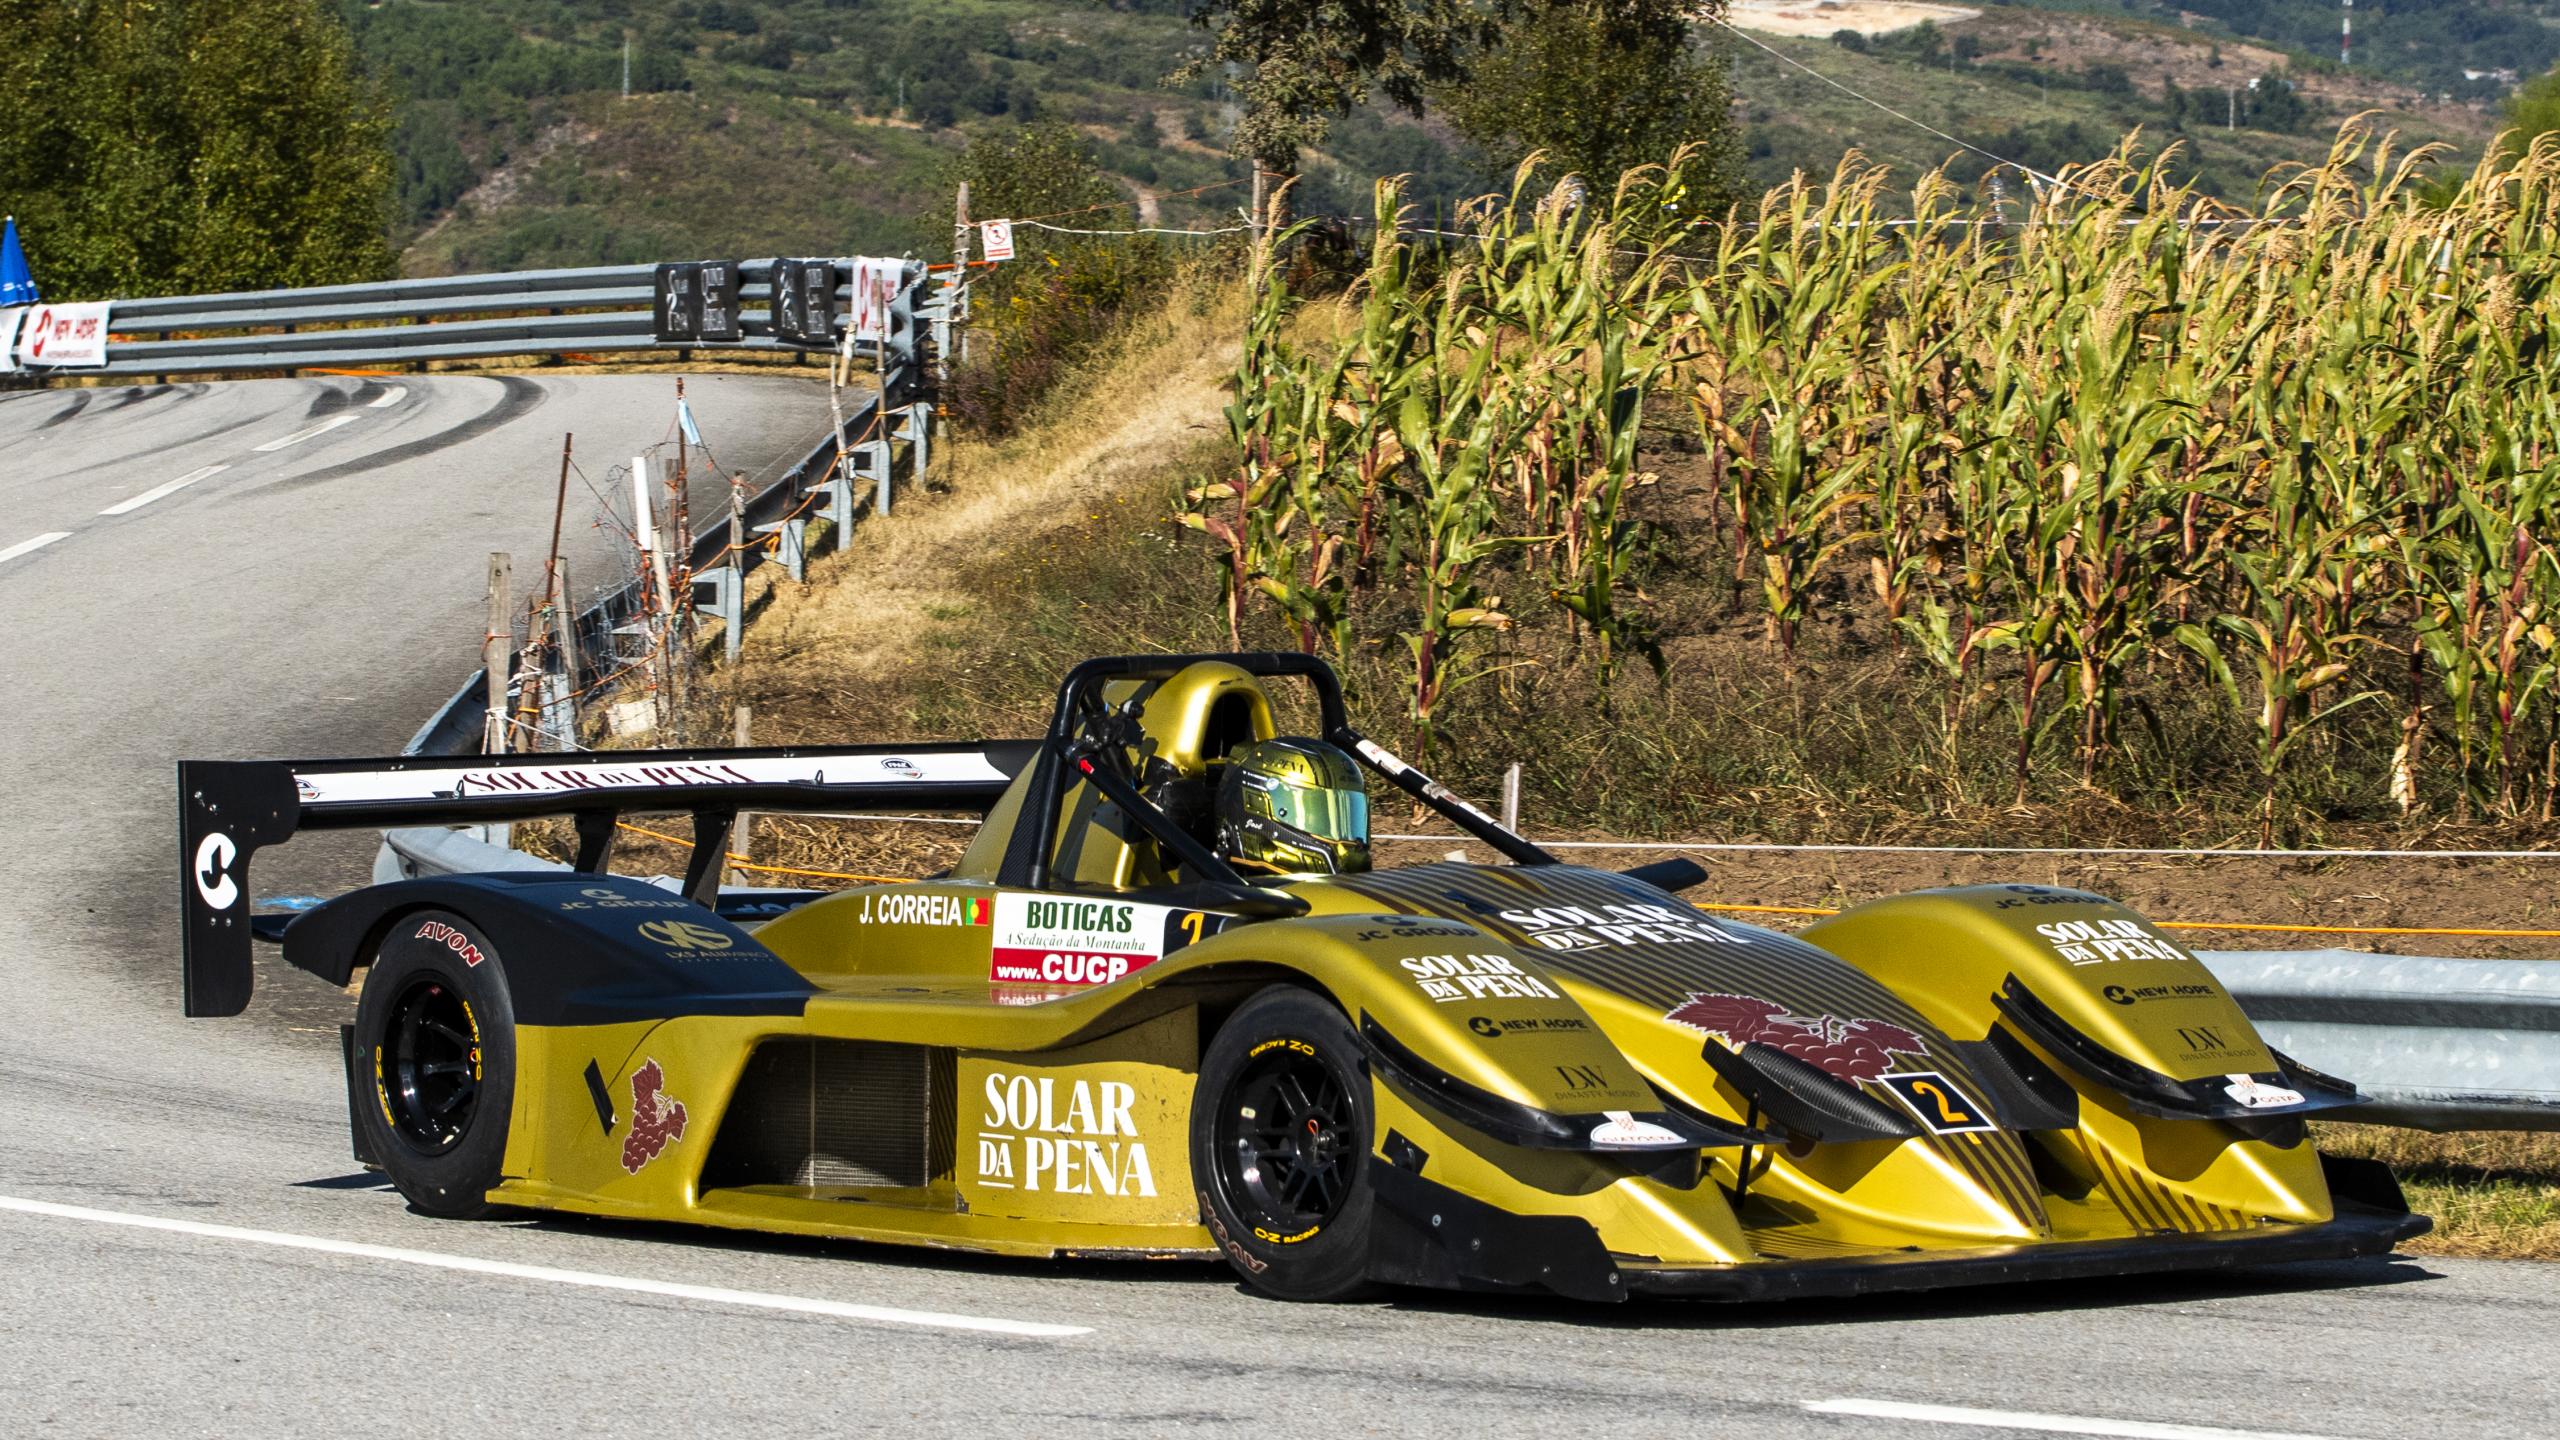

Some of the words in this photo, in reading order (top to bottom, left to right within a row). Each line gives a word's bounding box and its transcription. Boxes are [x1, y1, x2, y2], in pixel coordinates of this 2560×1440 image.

[463, 768, 600, 791] SOLAR
[561, 902, 592, 910] JC
[597, 900, 689, 908] GROUP
[859, 895, 873, 925] J.
[877, 894, 963, 927] CORREIA
[1994, 898, 2026, 909] JC
[1026, 901, 1134, 933] BOTICAS
[1500, 904, 1694, 931] SOLAR
[1014, 932, 1063, 949] Sedução
[1066, 935, 1080, 947] da
[1085, 936, 1146, 951] Montanha
[1357, 930, 1389, 941] JC
[1391, 927, 1479, 937] GROUP
[1533, 931, 1600, 950] DA
[1588, 923, 1751, 945] PENA
[2036, 919, 2153, 944] SOLAR
[415, 920, 485, 968] AVON
[2057, 946, 2098, 962] DA
[2092, 938, 2188, 962] PENA
[1400, 955, 1525, 979] SOLAR
[1424, 982, 1464, 999] DA
[1460, 975, 1560, 999] PENA
[2131, 986, 2169, 998] NEW
[2171, 985, 2214, 995] HOPE
[1500, 1020, 1539, 1030] NEW
[1541, 1019, 1588, 1029] HOPE
[984, 1072, 1139, 1136] SOLAR
[1911, 1080, 1970, 1122] 2
[979, 1140, 1014, 1178] DA
[1024, 1137, 1158, 1196] PENA
